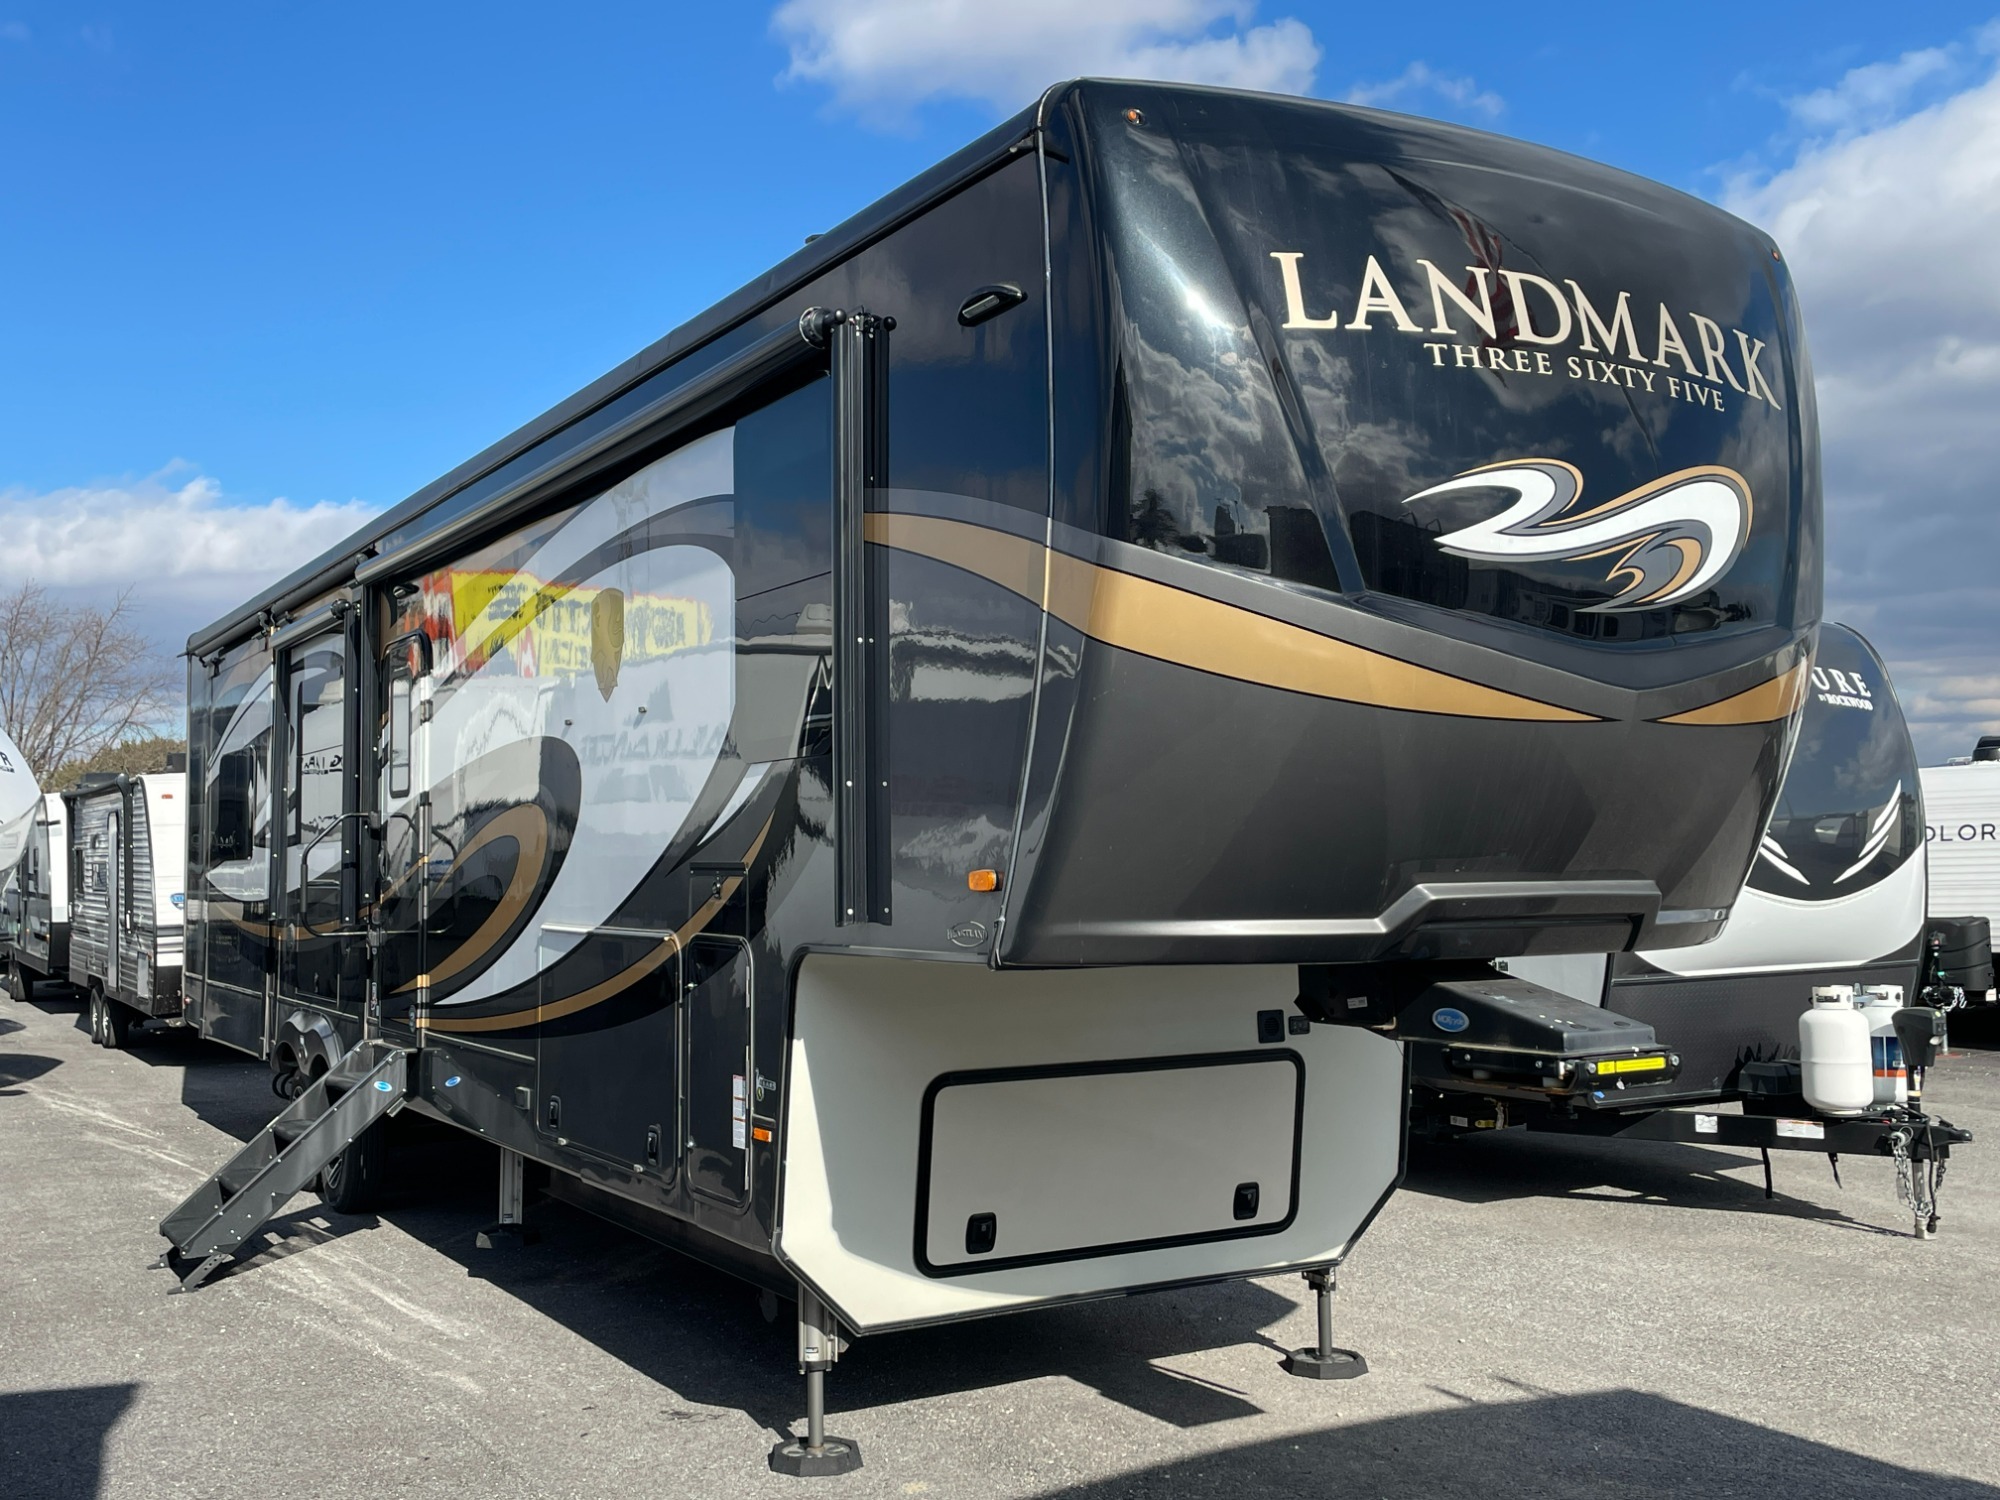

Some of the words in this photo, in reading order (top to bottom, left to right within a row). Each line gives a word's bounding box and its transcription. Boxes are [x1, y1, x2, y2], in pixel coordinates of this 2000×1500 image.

[1269, 251, 1782, 411] LANDMARK
[1423, 342, 1553, 375] THREE
[1567, 355, 1656, 393] SIXTY
[1667, 375, 1726, 413] FIVE
